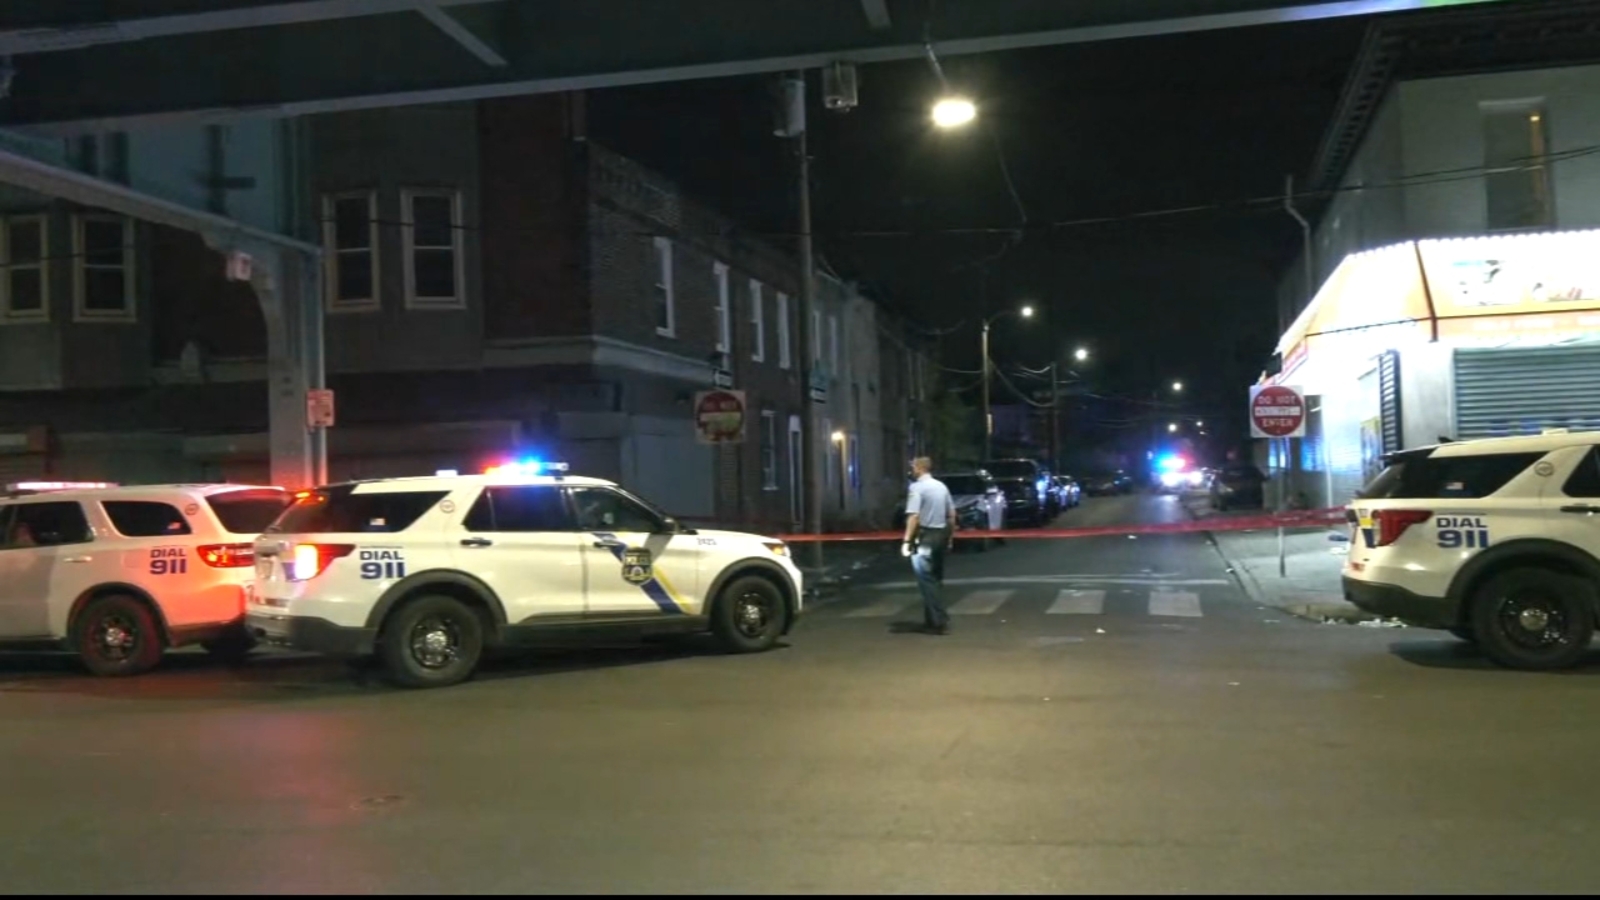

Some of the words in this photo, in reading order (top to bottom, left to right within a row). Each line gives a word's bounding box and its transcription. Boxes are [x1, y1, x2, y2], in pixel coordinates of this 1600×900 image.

[1262, 418, 1293, 428] ENTER
[1436, 517, 1488, 528] DIAL
[1436, 529, 1488, 548] 911
[150, 548, 187, 559] DIAL
[360, 550, 405, 561] DIAL
[150, 559, 187, 575] 911
[360, 562, 405, 579] 911
